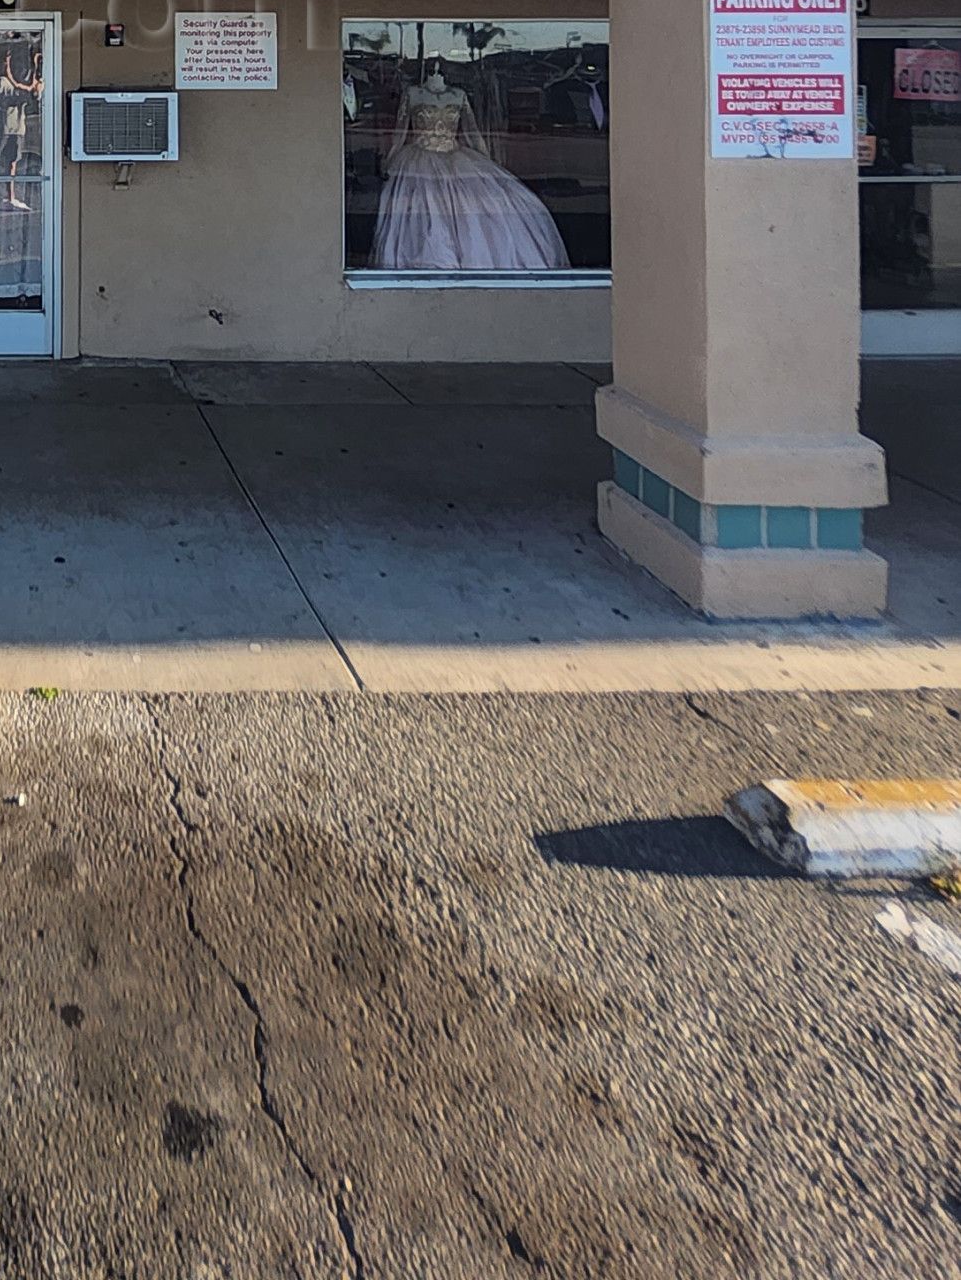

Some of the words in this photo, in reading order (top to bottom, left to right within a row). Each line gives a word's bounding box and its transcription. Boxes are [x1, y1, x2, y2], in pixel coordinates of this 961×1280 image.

[183, 19, 217, 29] Security
[219, 19, 248, 28] Guards
[251, 20, 264, 28] are
[768, 24, 820, 34] SUNNYMEAD
[180, 29, 221, 38] monitoring
[223, 29, 237, 37] this
[238, 29, 272, 38] property
[221, 39, 258, 47] computer
[716, 37, 745, 47] TENANT
[747, 37, 790, 47] EMPLOYEES
[792, 37, 807, 47] AND
[245, 66, 273, 74] guards
[182, 75, 225, 83] contacting
[721, 78, 770, 88] VIOLATING
[772, 78, 817, 88] VEHICLES
[818, 78, 842, 88] WILL
[722, 90, 734, 99] BE
[736, 90, 765, 99] TOWED
[767, 90, 791, 99] AWAY
[792, 90, 804, 99] AT
[804, 90, 841, 99] VEHICLE
[782, 101, 835, 111] EXPENSE
[721, 134, 755, 144] MVPD
